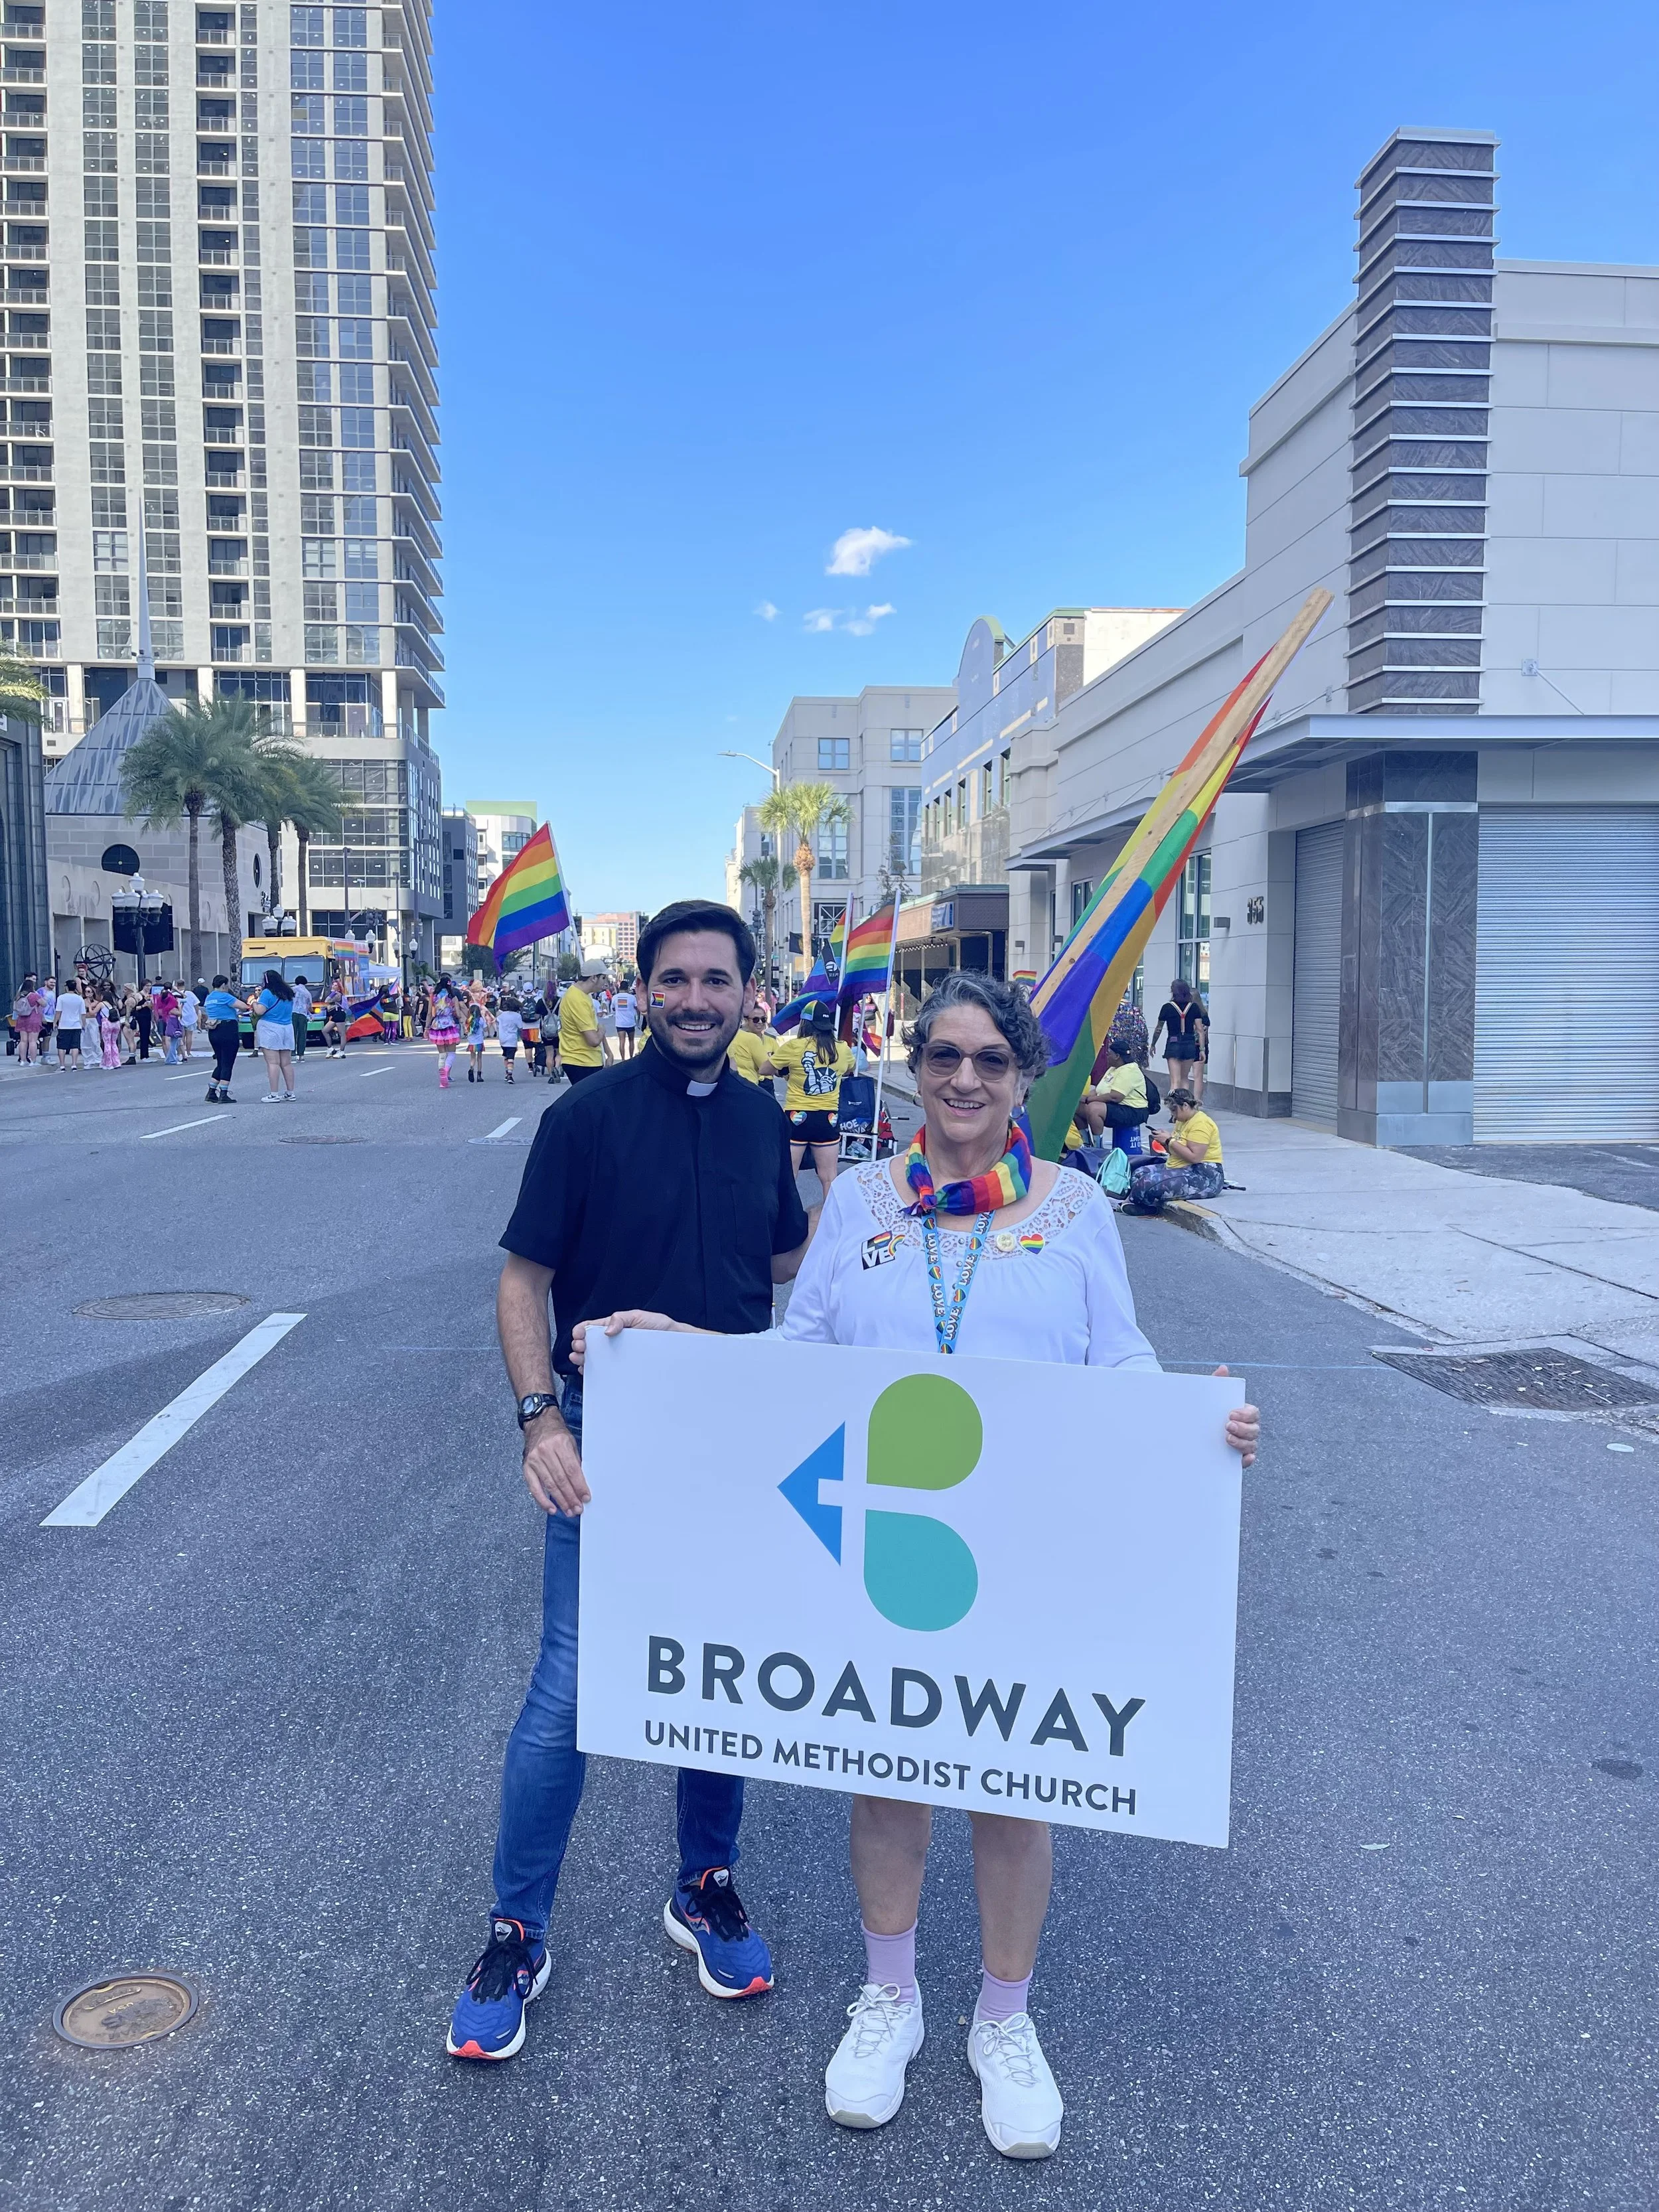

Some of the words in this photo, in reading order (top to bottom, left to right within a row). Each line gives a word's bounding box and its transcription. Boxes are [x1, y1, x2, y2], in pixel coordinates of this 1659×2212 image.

[925, 1232, 939, 1264] LOVE
[958, 1253, 978, 1286] LOVE
[931, 1283, 946, 1317] LOVE
[944, 1306, 963, 1341] LOVE
[648, 1635, 1146, 1757] BROADWAY
[645, 1720, 763, 1760] UNITED
[772, 1737, 971, 1791] METHODIST
[980, 1769, 1137, 1816] CHURCH
[108, 2002, 134, 2014] USA
